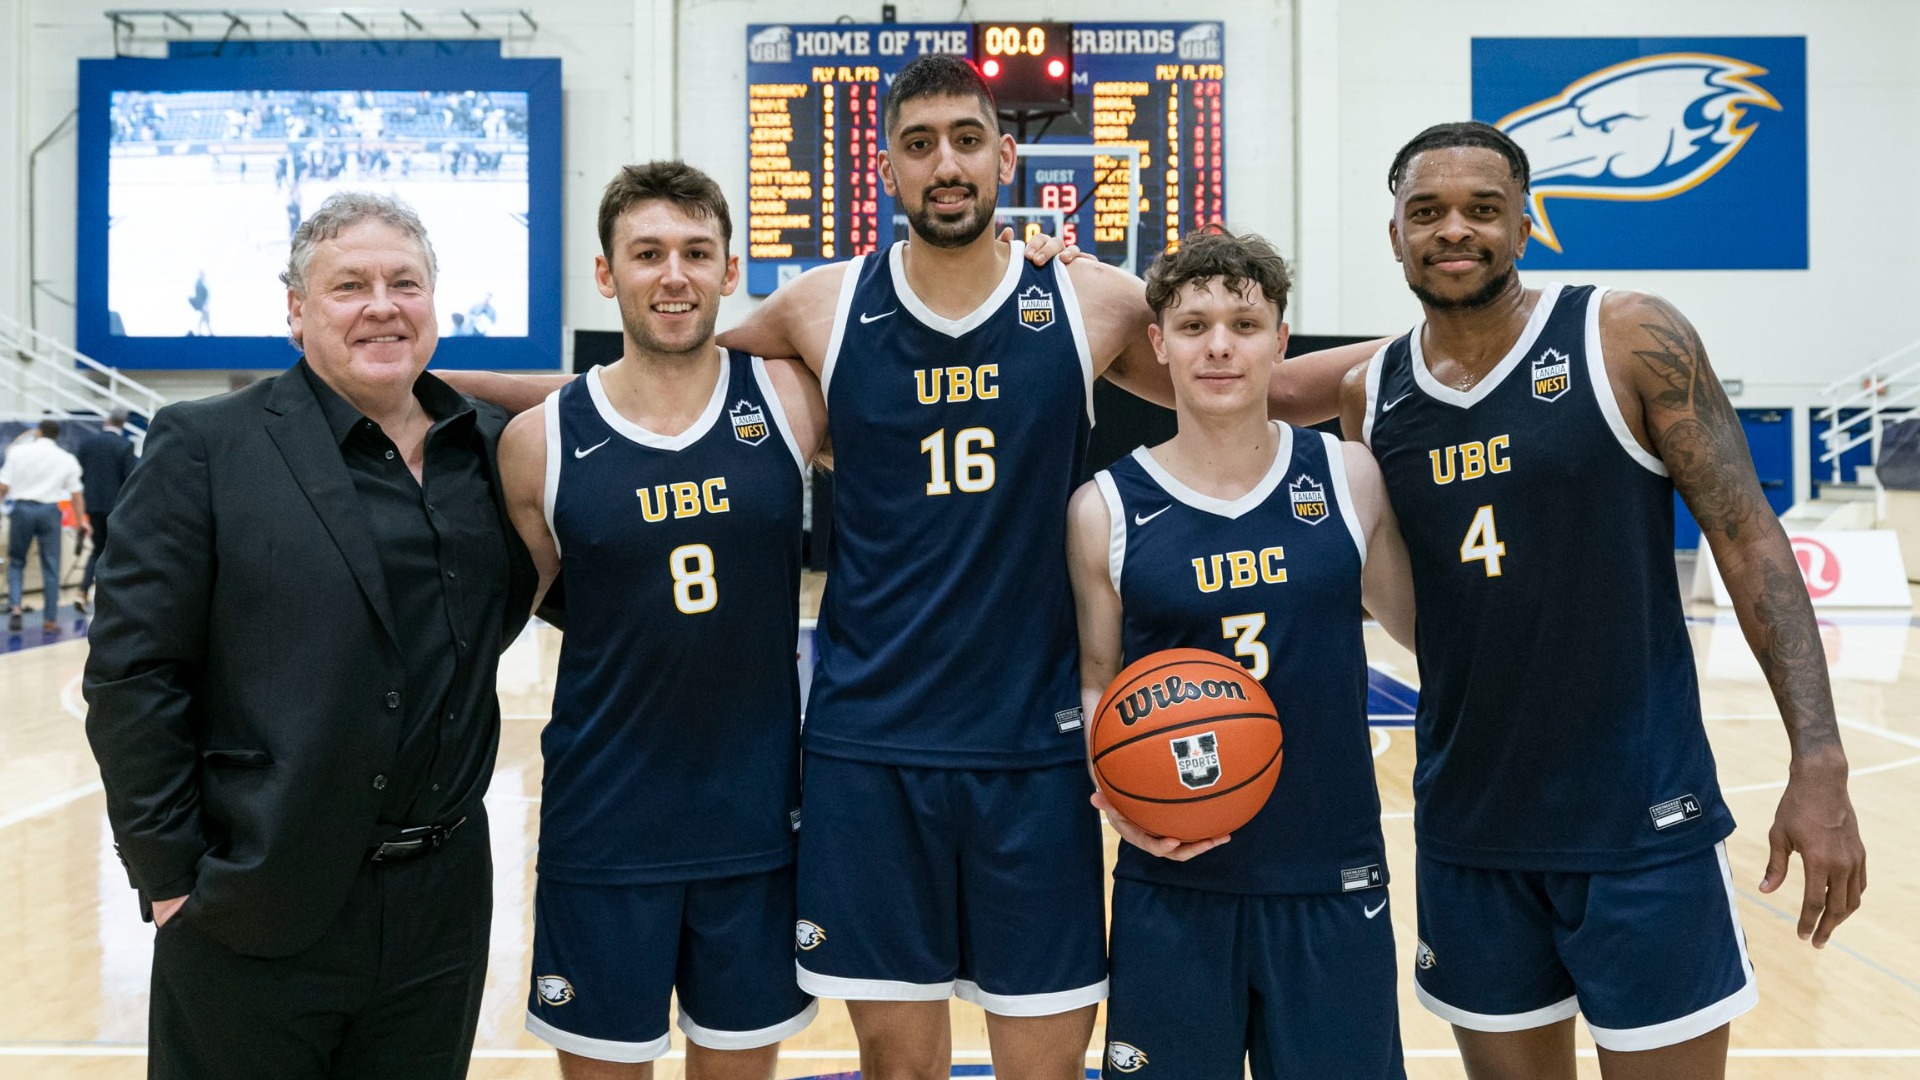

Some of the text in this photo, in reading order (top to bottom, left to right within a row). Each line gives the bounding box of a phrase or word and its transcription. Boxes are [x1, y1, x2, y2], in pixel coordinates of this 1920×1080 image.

[796, 31, 871, 56] HOME
[877, 31, 911, 56] OF
[914, 30, 968, 55] THE
[985, 27, 1046, 56] 00.0
[855, 66, 880, 82] PTS
[1199, 64, 1224, 81] PTS
[1035, 168, 1075, 184] GUEST
[1021, 299, 1051, 309] CANADA
[1023, 309, 1051, 323] WEST
[1534, 364, 1567, 378] CANADA
[914, 363, 1000, 405] UBC
[1536, 375, 1566, 395] WEST
[734, 413, 762, 425] CANADA
[737, 423, 766, 439] WEST
[920, 426, 996, 496] 16
[1429, 434, 1511, 485] UBC
[636, 476, 730, 523] UBC
[1293, 491, 1323, 502] CANADA
[1295, 502, 1324, 517] WEST
[1459, 504, 1506, 578] 4
[669, 543, 718, 615] 8
[1191, 546, 1288, 593] UBC
[1221, 612, 1270, 681] 3
[1115, 675, 1247, 727] Wilson
[1178, 753, 1218, 772] SPORTS
[1683, 800, 1699, 814] XL
[1371, 870, 1379, 882] M
